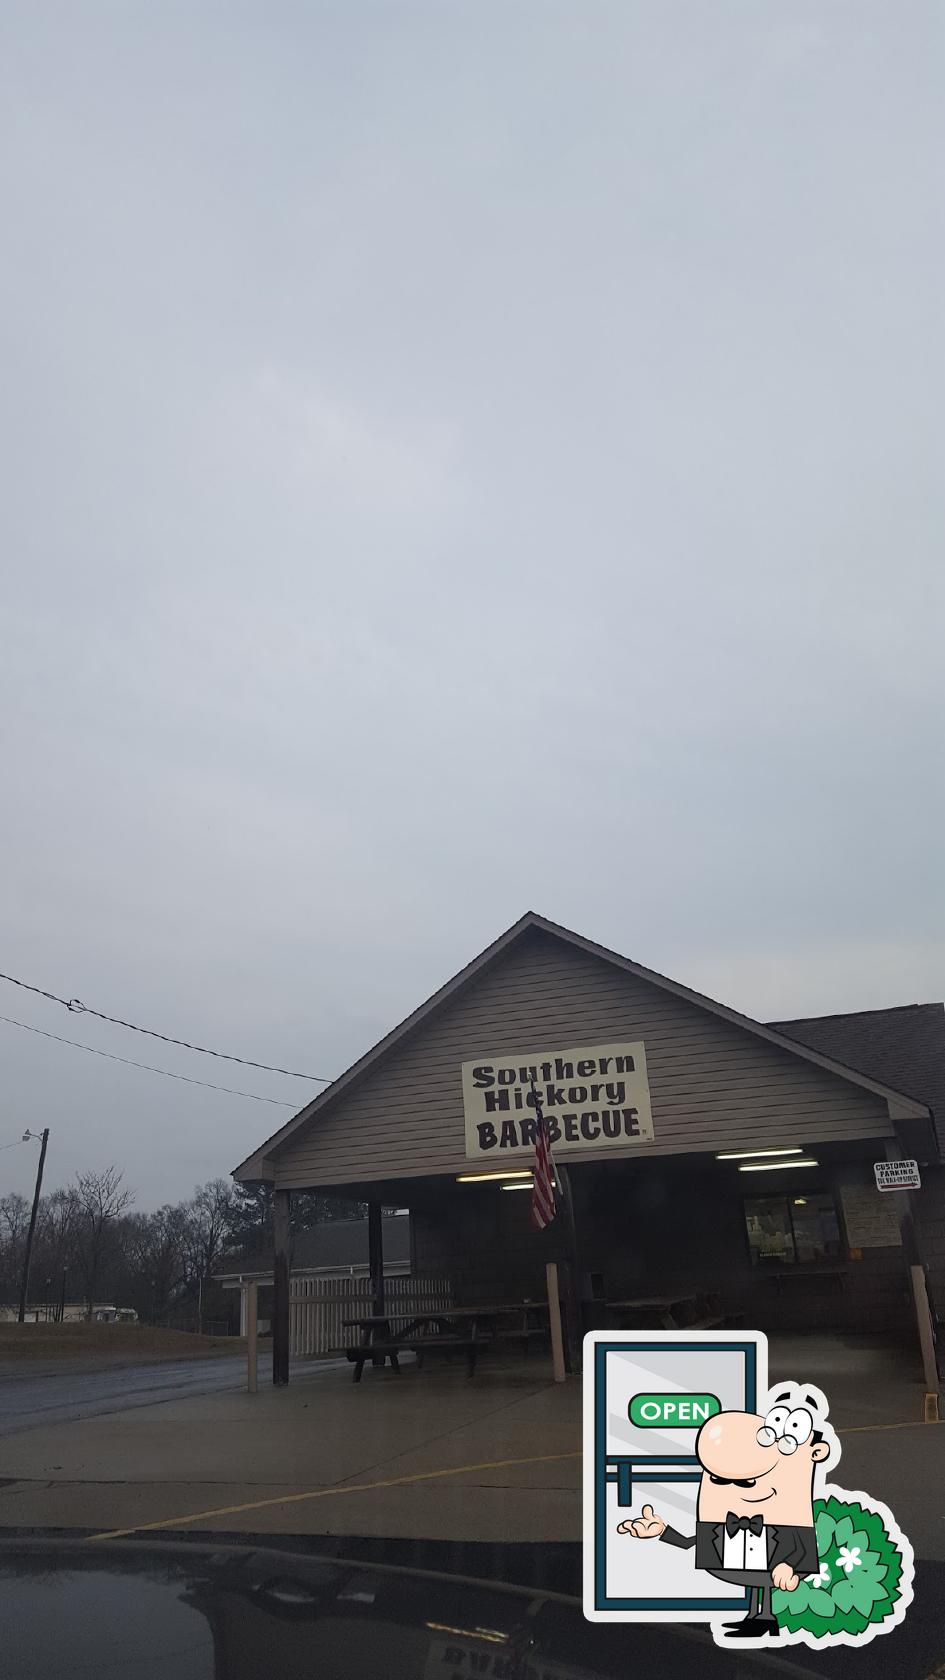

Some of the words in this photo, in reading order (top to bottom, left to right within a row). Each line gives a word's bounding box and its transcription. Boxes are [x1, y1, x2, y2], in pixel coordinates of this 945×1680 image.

[472, 1055, 636, 1089] Southern
[484, 1081, 626, 1113] Hickory
[476, 1107, 641, 1150] BARBECUE
[875, 1162, 915, 1171] CUSTOMER
[880, 1169, 914, 1178] PARKING
